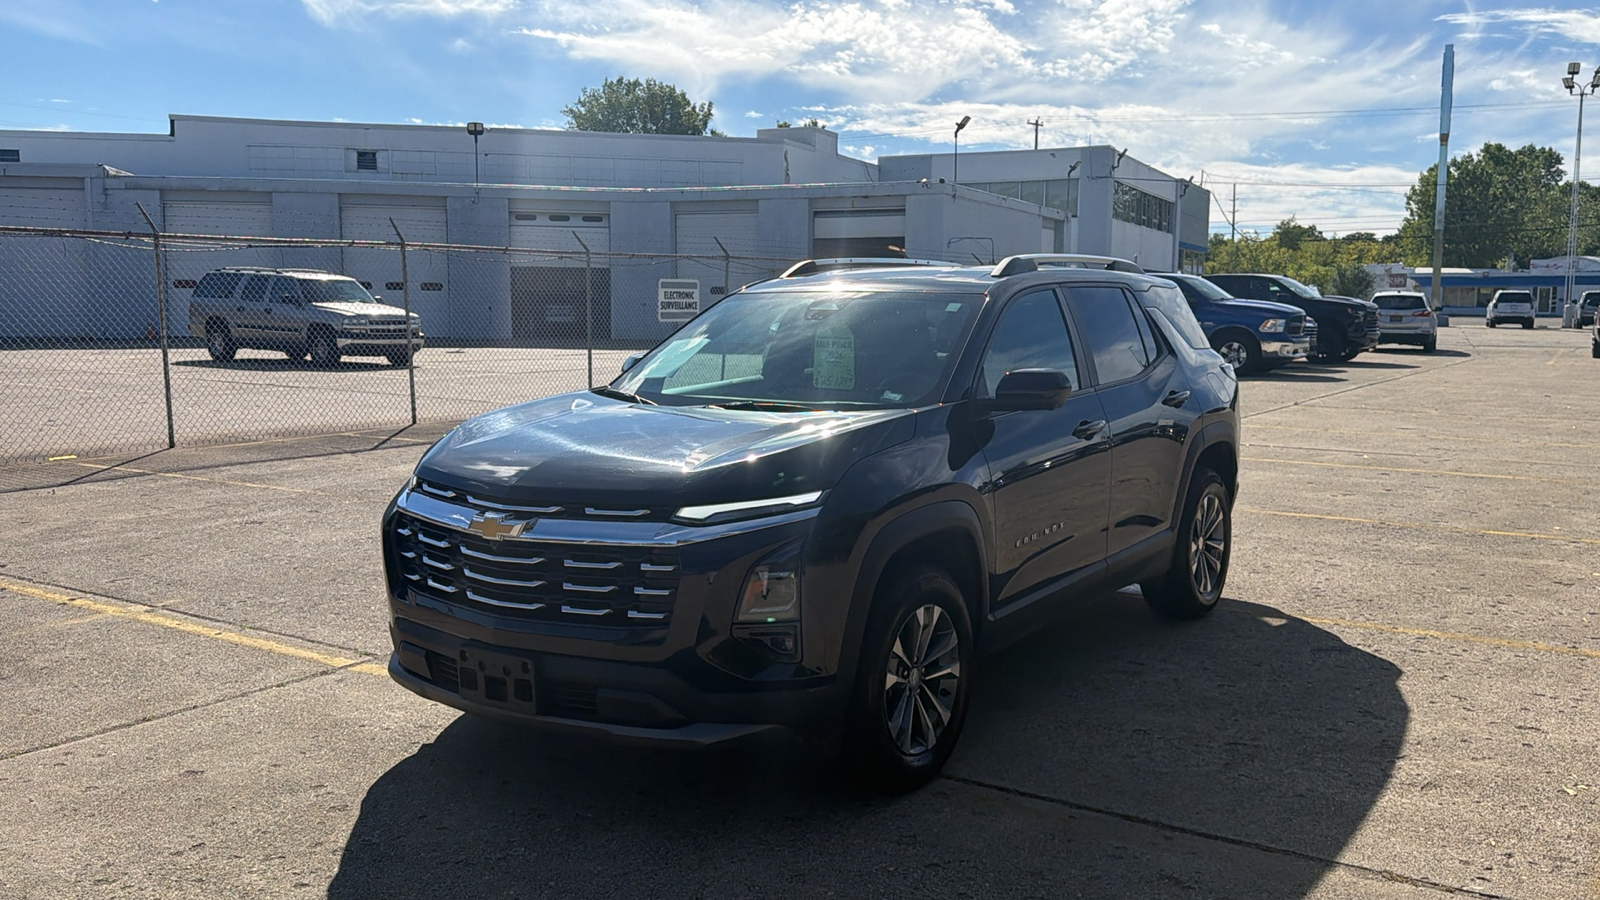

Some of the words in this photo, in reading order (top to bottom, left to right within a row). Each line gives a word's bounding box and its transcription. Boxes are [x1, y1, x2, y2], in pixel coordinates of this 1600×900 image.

[663, 291, 695, 300] ELECTRONIC
[660, 301, 698, 310] SURVEILLANCE
[815, 340, 831, 348] SALE
[831, 340, 853, 349] PRICE
